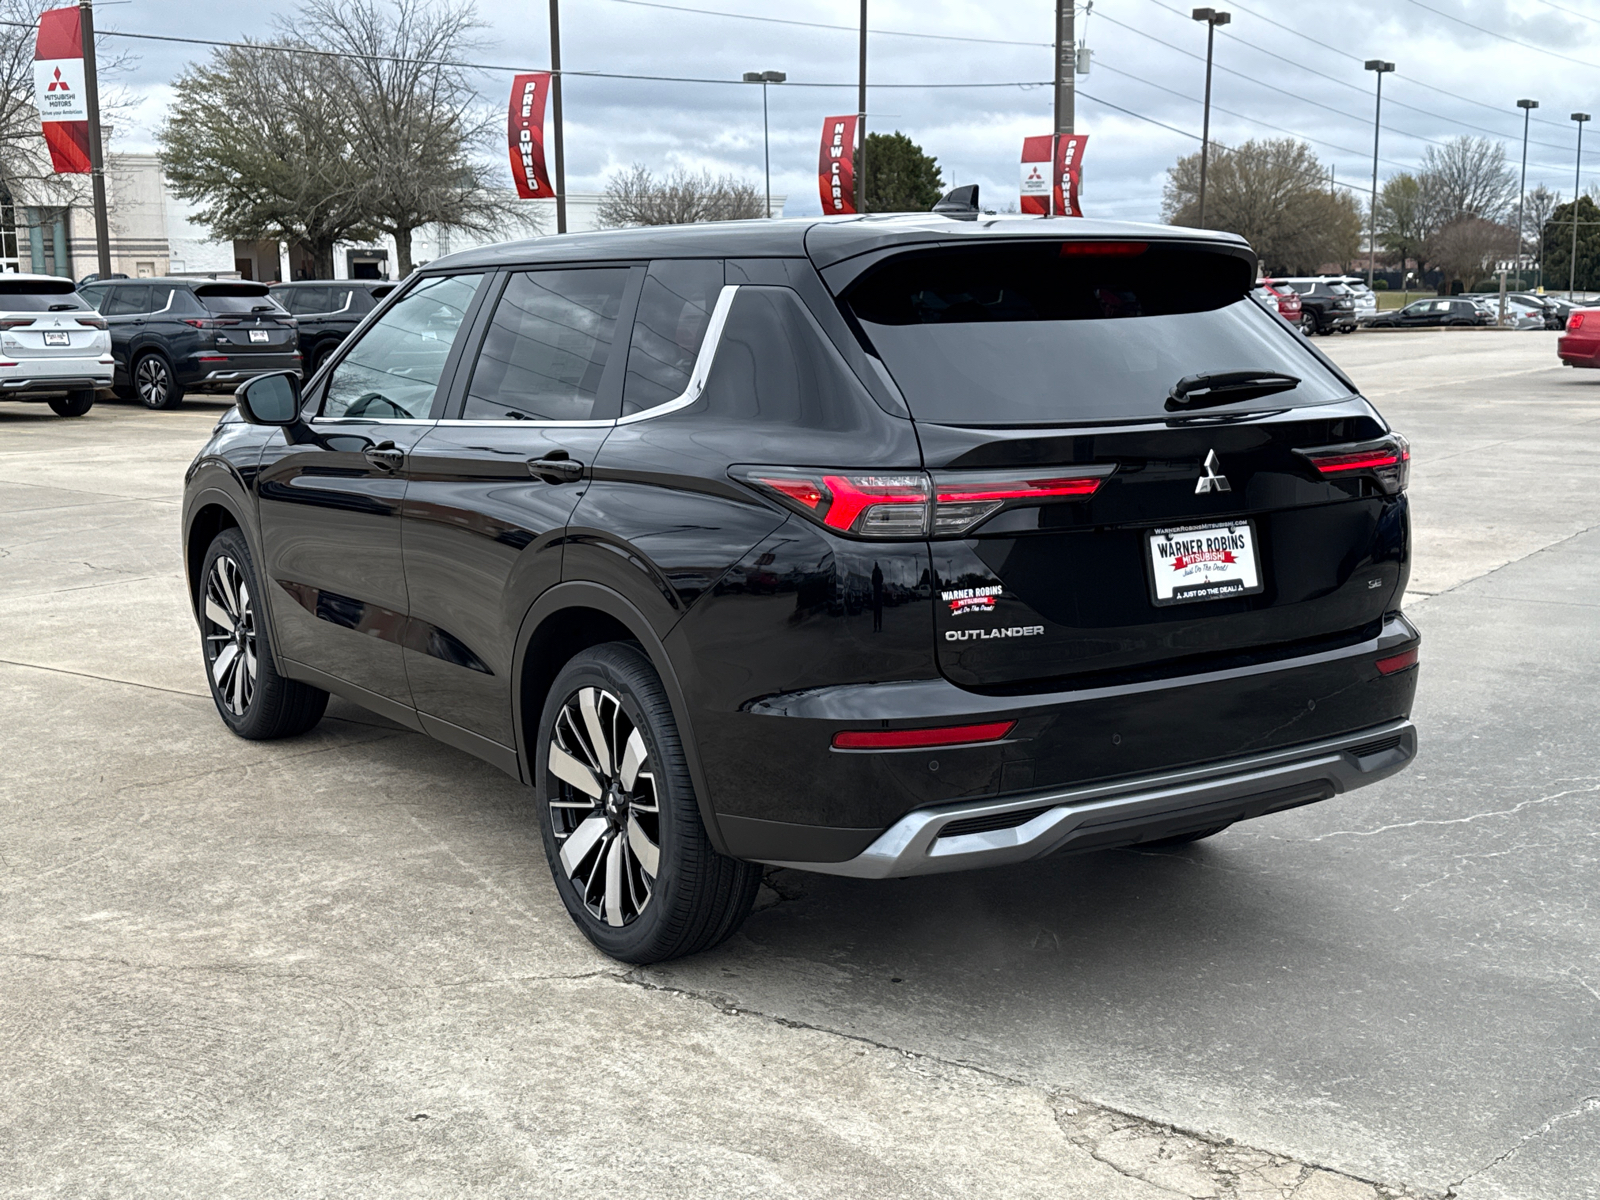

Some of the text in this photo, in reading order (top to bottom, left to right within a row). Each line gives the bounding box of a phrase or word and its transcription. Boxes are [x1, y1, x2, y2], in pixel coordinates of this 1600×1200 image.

[518, 82, 539, 190] PRE-OWNED
[830, 123, 844, 209] NEW CARS
[1061, 140, 1077, 215] PRE-OWNED
[1157, 534, 1245, 558] WARNER ROBINS
[1182, 550, 1225, 565] MITSUBISHI
[1182, 568, 1194, 577] Just
[1195, 565, 1201, 573] Do
[1182, 590, 1197, 598] JUST
[1220, 585, 1237, 593] DEAL!
[1368, 578, 1382, 589] SE
[941, 585, 1002, 601] WARNER ROBINS
[945, 625, 1045, 641] OUTLANDER
